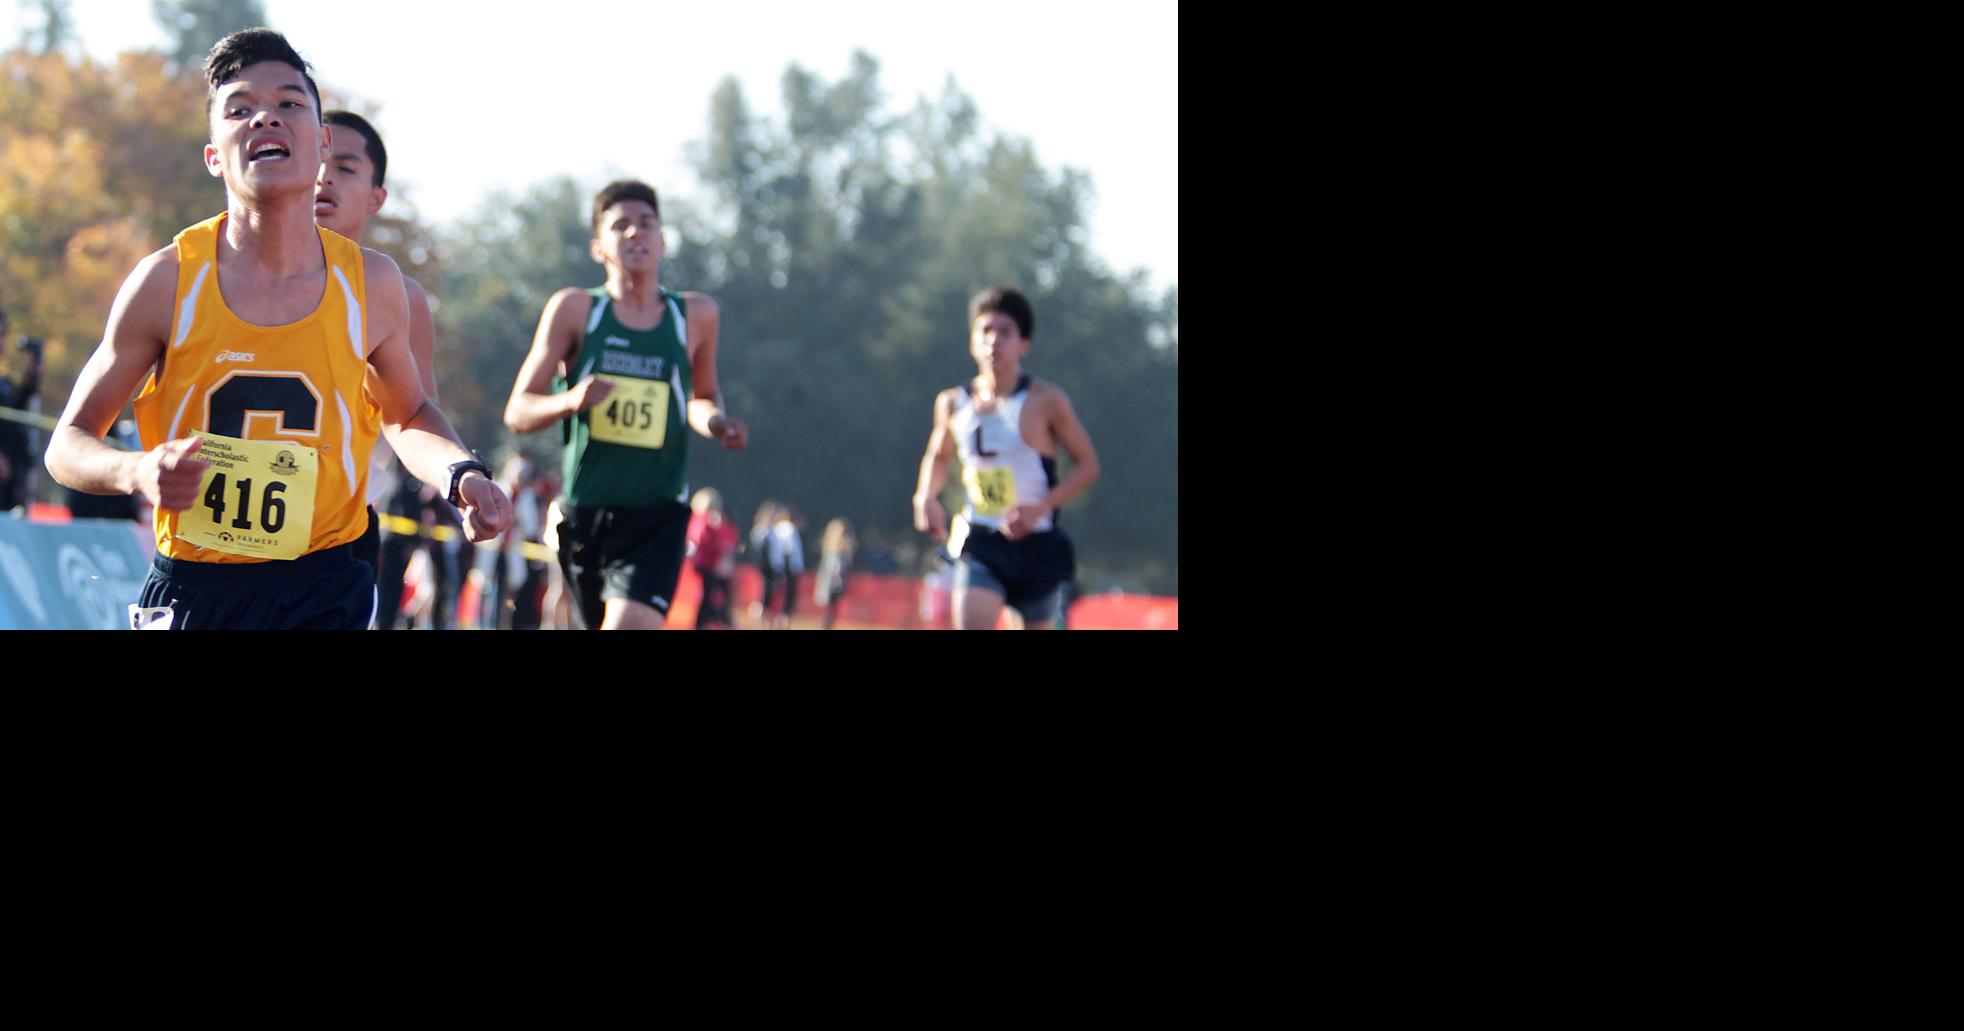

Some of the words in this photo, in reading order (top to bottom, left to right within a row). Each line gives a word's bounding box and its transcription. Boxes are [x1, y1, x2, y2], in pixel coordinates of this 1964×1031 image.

[605, 398, 652, 430] 405
[199, 447, 250, 463] nterscholastic
[204, 472, 288, 534] 416
[236, 534, 279, 546] FARMERS
